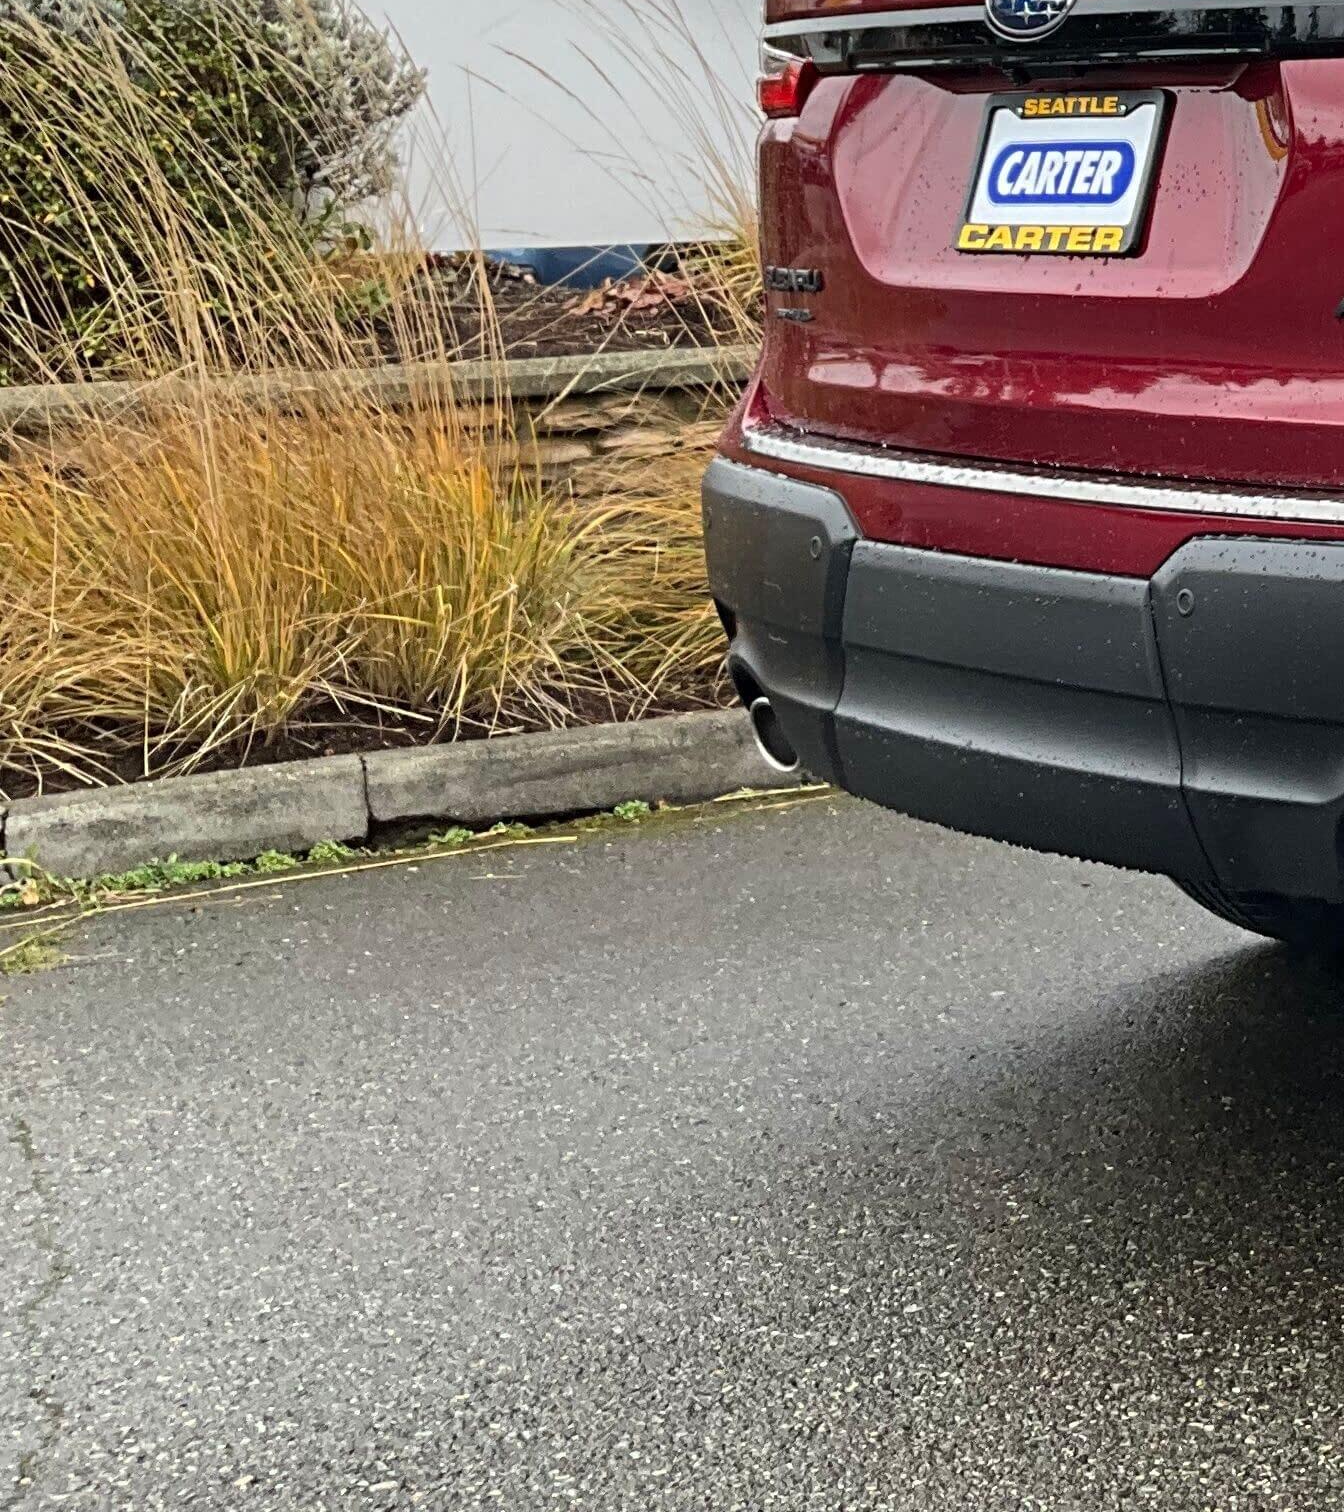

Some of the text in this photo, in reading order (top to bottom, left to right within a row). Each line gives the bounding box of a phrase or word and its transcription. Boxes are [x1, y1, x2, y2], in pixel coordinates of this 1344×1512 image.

[1024, 96, 1120, 116] SEATTLE
[997, 149, 1123, 196] CARTER
[958, 223, 1124, 252] CARTER
